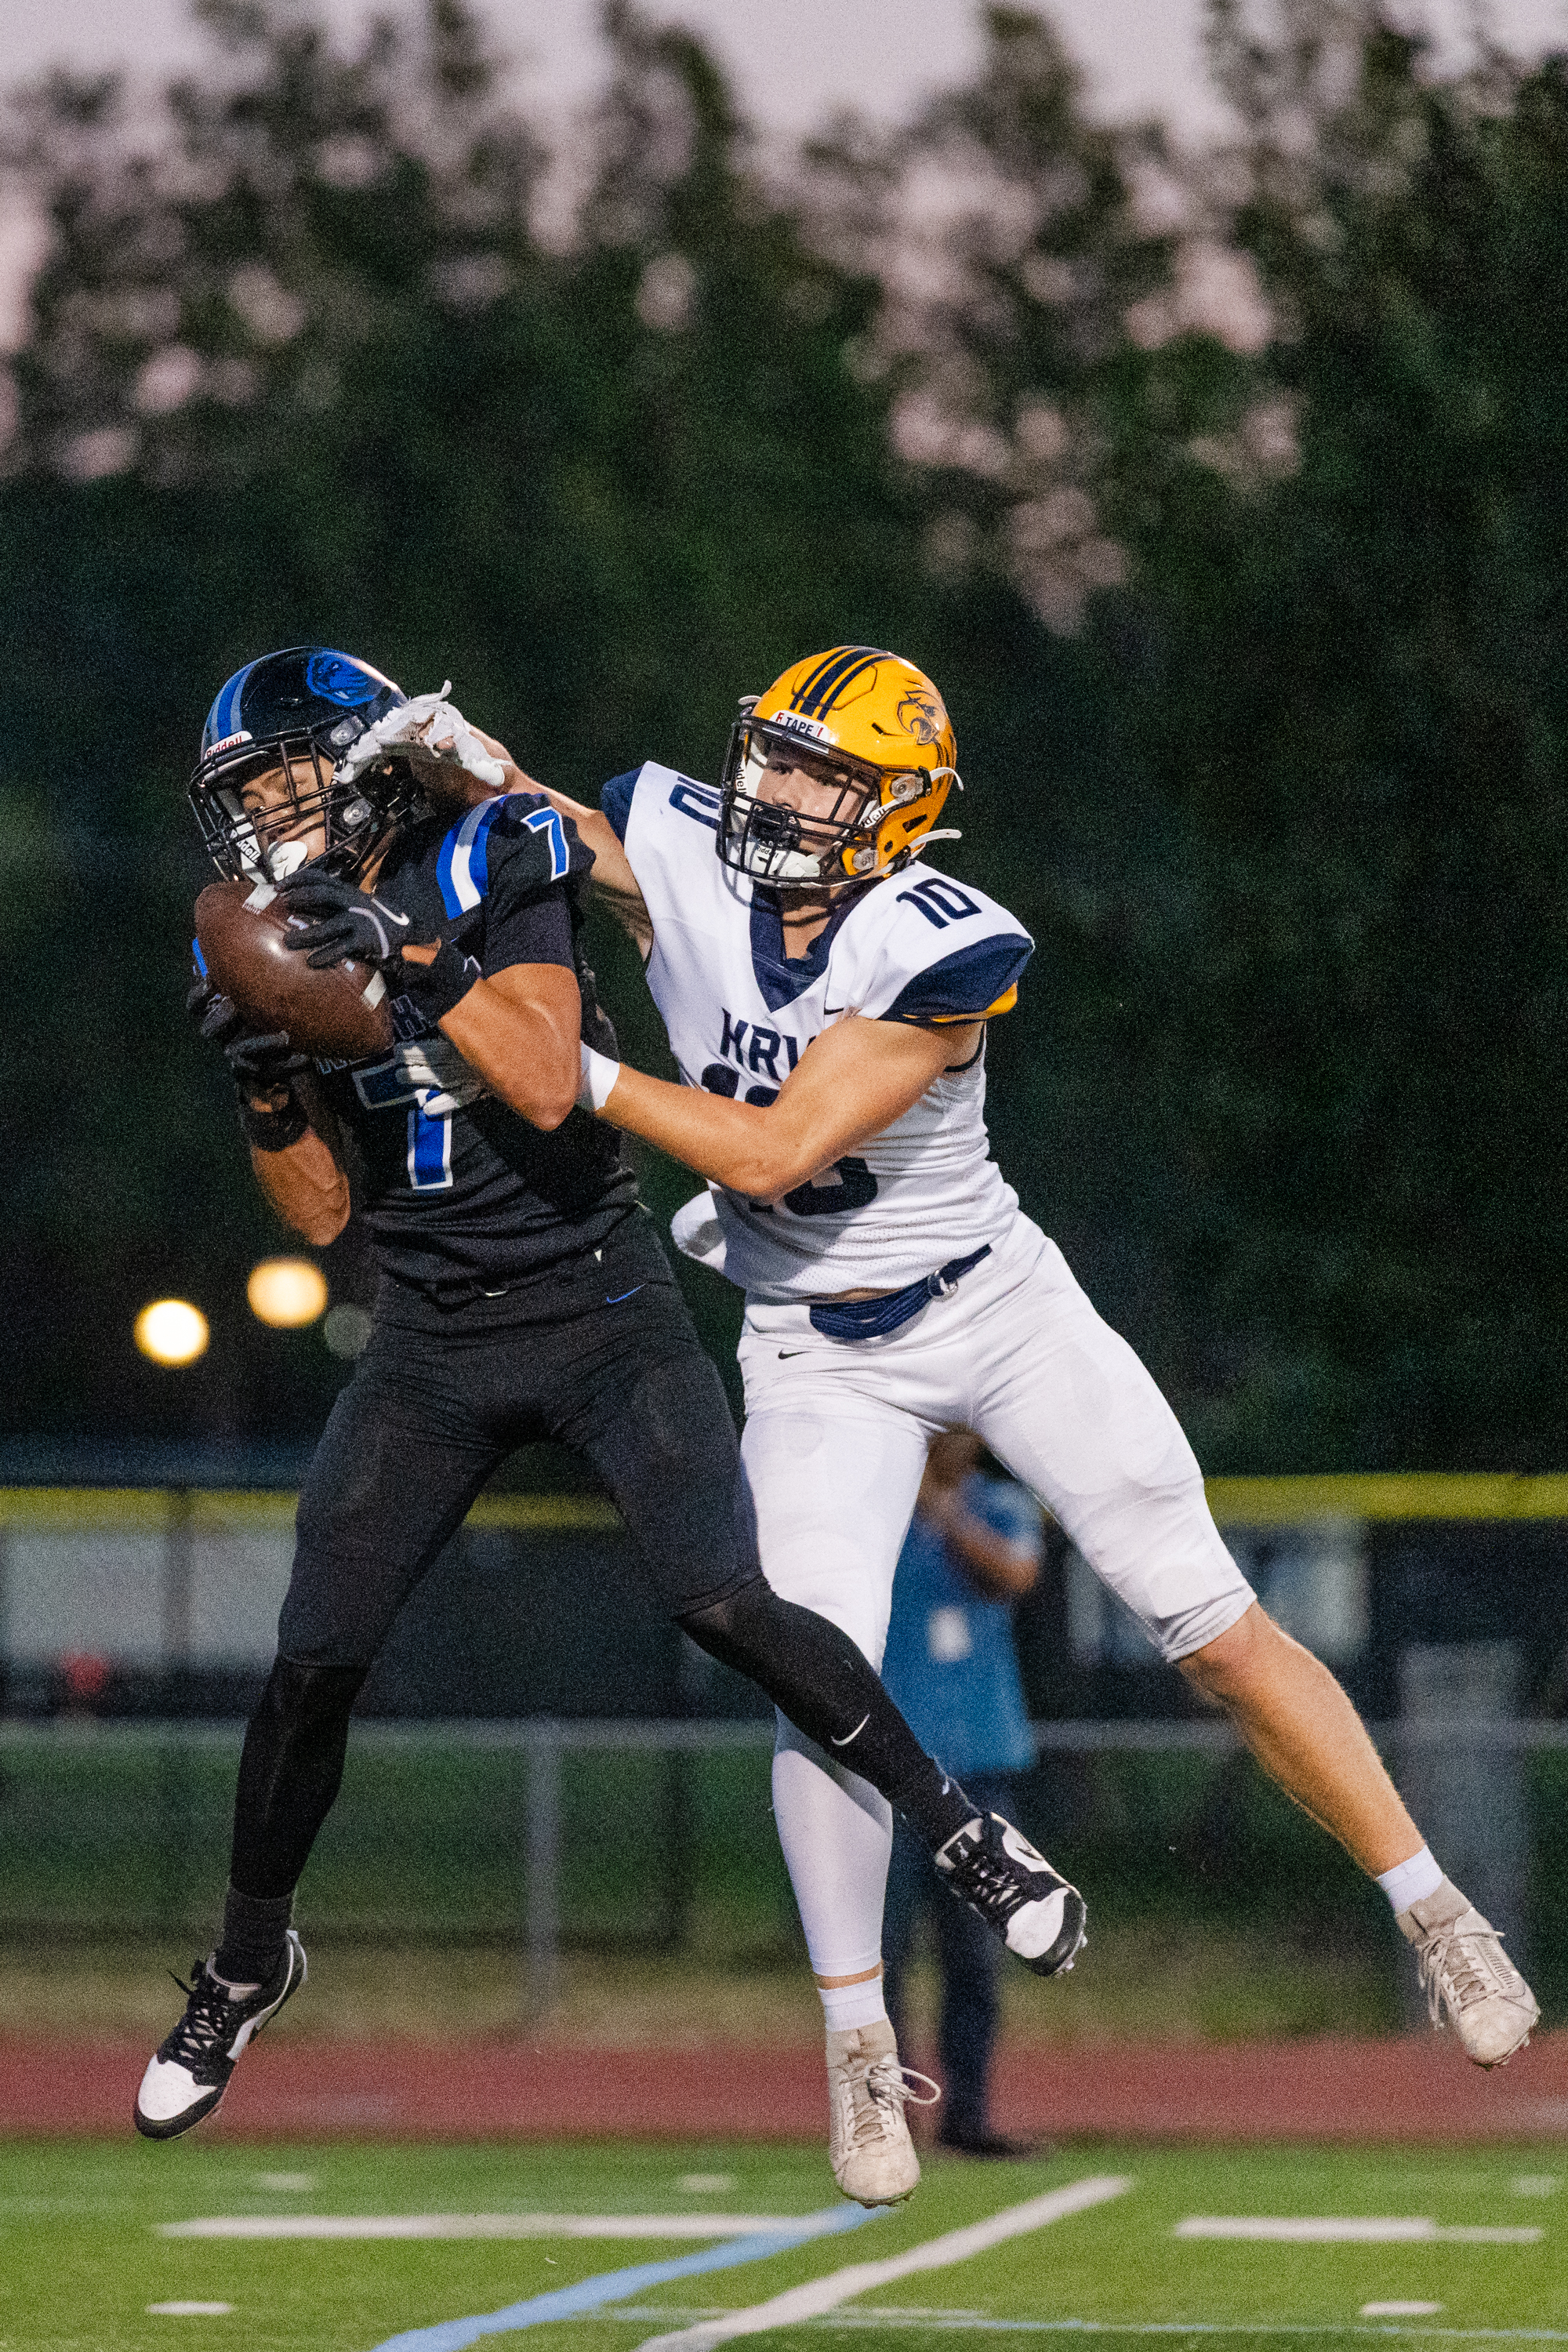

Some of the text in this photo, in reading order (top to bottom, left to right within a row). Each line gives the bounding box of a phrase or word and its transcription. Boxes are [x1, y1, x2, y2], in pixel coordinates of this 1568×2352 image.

[786, 717, 814, 736] TAPE
[230, 829, 260, 862] Rddell
[520, 806, 569, 881] 7
[895, 878, 982, 929] 10
[351, 1058, 453, 1189] 7
